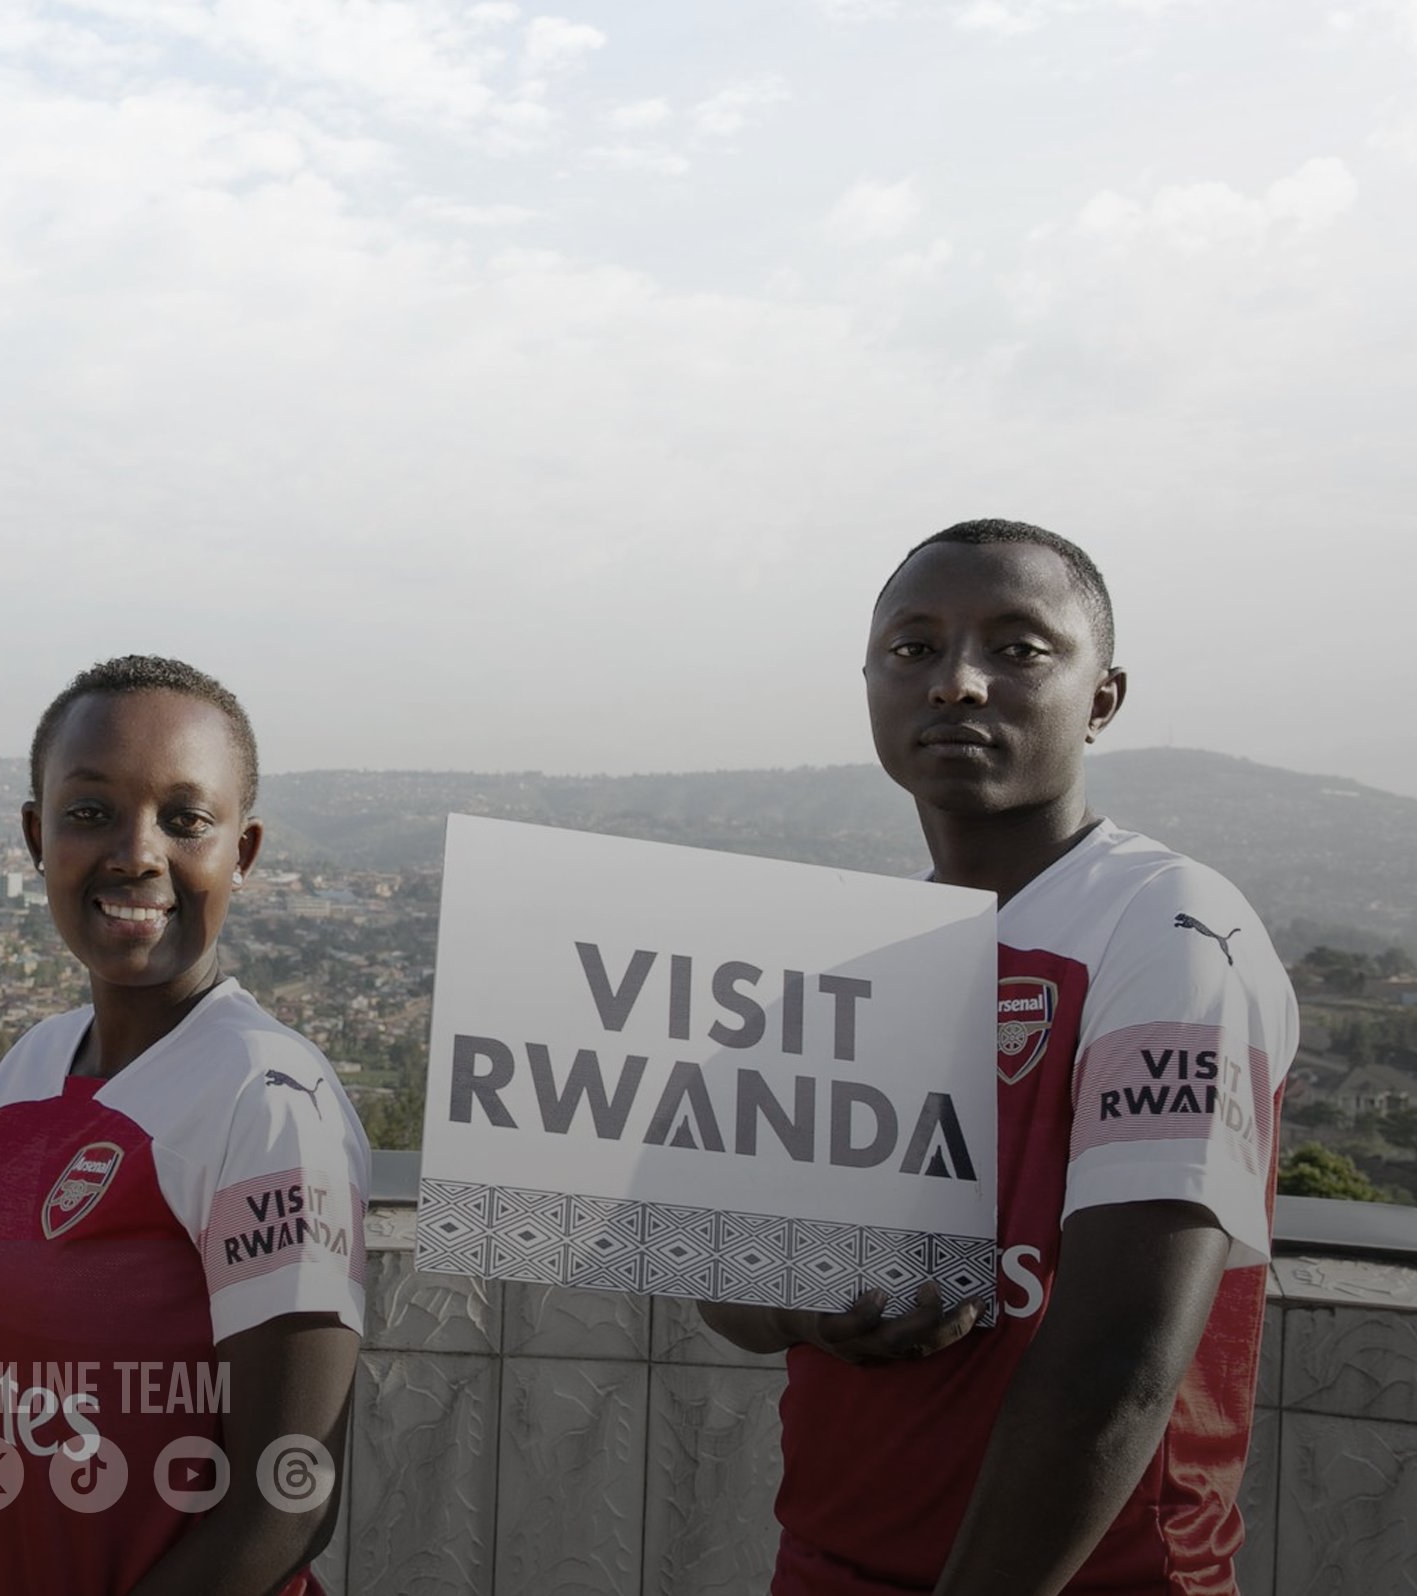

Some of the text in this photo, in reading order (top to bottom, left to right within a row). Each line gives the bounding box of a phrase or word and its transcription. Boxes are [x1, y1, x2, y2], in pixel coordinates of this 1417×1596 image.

[573, 941, 872, 1062] VISIT
[998, 994, 1043, 1012] rsenal
[1141, 1049, 1241, 1093] VISIT
[448, 1034, 977, 1182] RWANDA
[1100, 1084, 1254, 1143] RWANDA
[246, 1185, 327, 1223] VISIT
[224, 1217, 348, 1265] RWANDA
